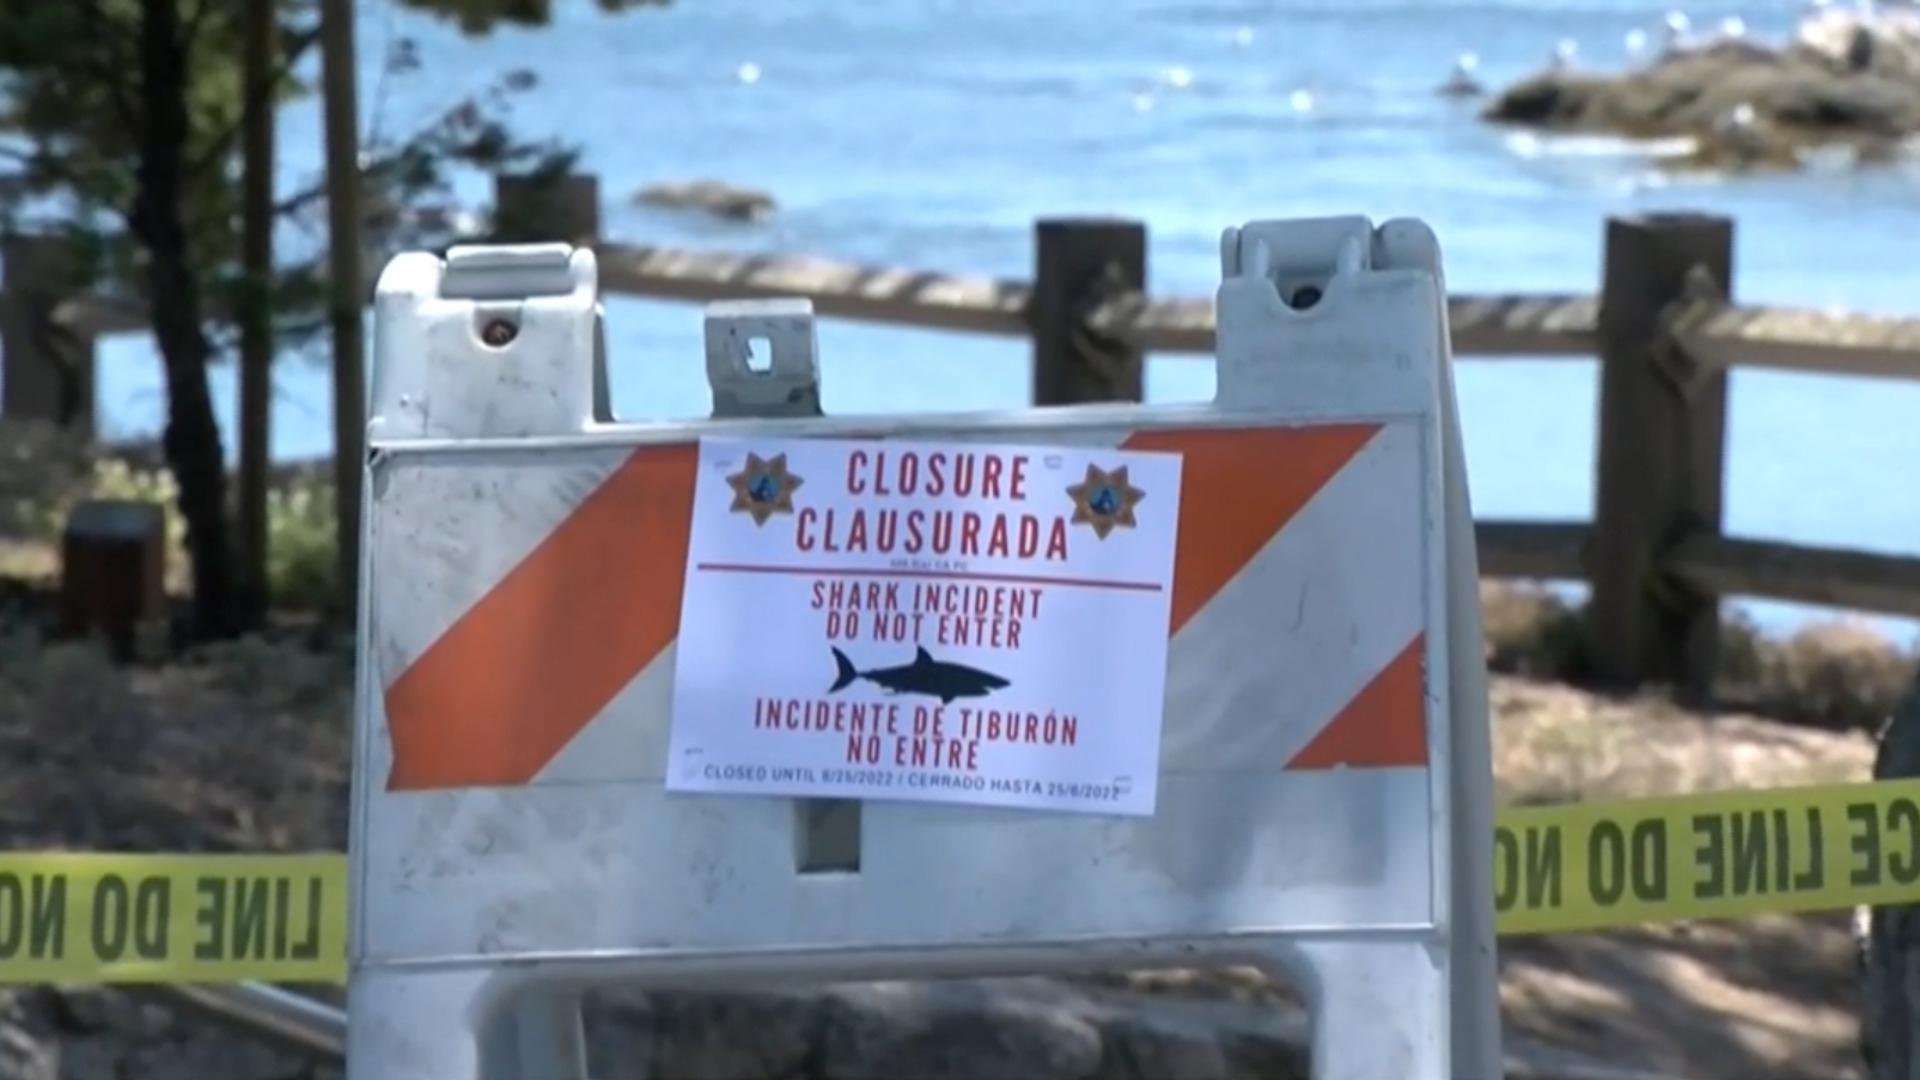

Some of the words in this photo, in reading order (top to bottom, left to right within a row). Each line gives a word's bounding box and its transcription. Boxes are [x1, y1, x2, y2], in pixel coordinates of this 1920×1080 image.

[847, 450, 1028, 500] CLOSURE
[796, 507, 1067, 561] CLAUSURADA
[811, 580, 898, 609] SHARK
[914, 583, 1043, 619] INCIDENT
[827, 611, 859, 640] DO
[873, 613, 924, 643] NOT
[938, 615, 1021, 648] ENTER
[755, 698, 900, 735] INCIDENTE
[914, 705, 945, 737] DE
[960, 706, 1077, 746] TIBURÓN
[847, 735, 881, 765] NO
[896, 737, 979, 770] ENTRE
[704, 764, 767, 782] CLOSED
[772, 767, 815, 783] UNTIL
[908, 773, 985, 791] CERRADO
[991, 776, 1042, 795] HASTA
